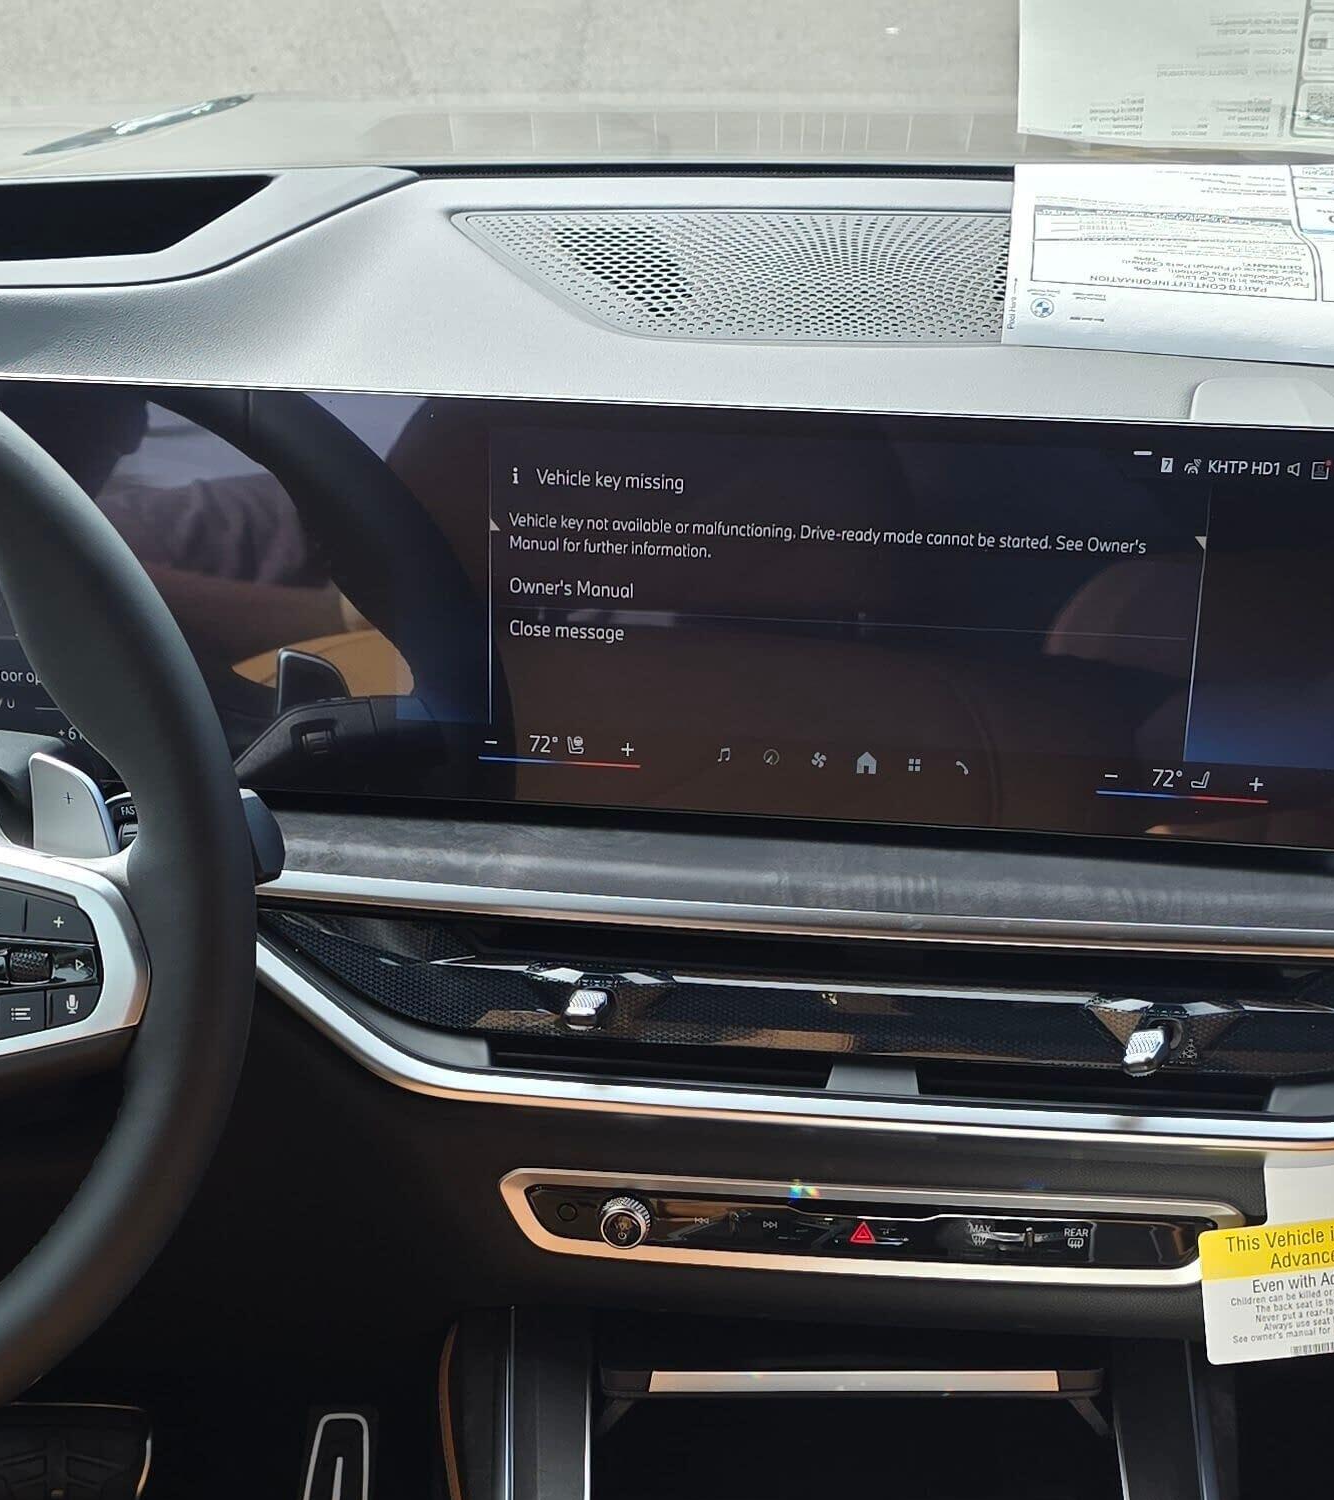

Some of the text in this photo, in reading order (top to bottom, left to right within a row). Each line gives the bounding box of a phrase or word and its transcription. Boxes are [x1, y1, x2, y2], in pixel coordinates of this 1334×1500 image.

[1090, 275, 1169, 287] INFORMATION
[1171, 281, 1226, 290] CONTENT
[1207, 460, 1280, 476] KHTP HD1
[536, 468, 684, 494] Vehicle key missing
[509, 512, 557, 530] Vehicle
[561, 515, 583, 532] key
[587, 518, 609, 531] not
[613, 517, 671, 535] available
[675, 521, 689, 535] or
[800, 524, 880, 546] Drive-ready
[883, 529, 923, 545] mode
[926, 531, 975, 547] cannot
[977, 533, 995, 548] be
[999, 534, 1052, 551] started.
[1055, 536, 1083, 552] See
[1087, 537, 1147, 554] Owner's
[509, 536, 712, 559] Manual for further information.
[509, 577, 634, 599] Owner's Manual
[509, 620, 624, 644] Close message
[969, 1223, 992, 1234] MAX
[1064, 1228, 1089, 1238] REAR
[1226, 1234, 1260, 1254] This
[1265, 1226, 1324, 1249] Vehicle
[1252, 1277, 1284, 1294] Even
[1288, 1273, 1317, 1291] with
[1230, 1296, 1266, 1307] Children
[1269, 1295, 1283, 1303] can
[1286, 1292, 1296, 1300] be
[1299, 1289, 1321, 1299] killed
[1324, 1289, 1333, 1297] or
[1255, 1305, 1271, 1313] The
[1274, 1302, 1293, 1312] back
[1296, 1301, 1313, 1309] seat
[1255, 1314, 1279, 1323] Never
[1282, 1312, 1296, 1321] put
[1264, 1321, 1293, 1332] Always
[1296, 1320, 1310, 1328] use
[1313, 1317, 1331, 1326] seat
[1232, 1335, 1248, 1344] See
[1250, 1331, 1283, 1343] owner's
[1286, 1328, 1316, 1338] manual
[1318, 1326, 1331, 1335] for
